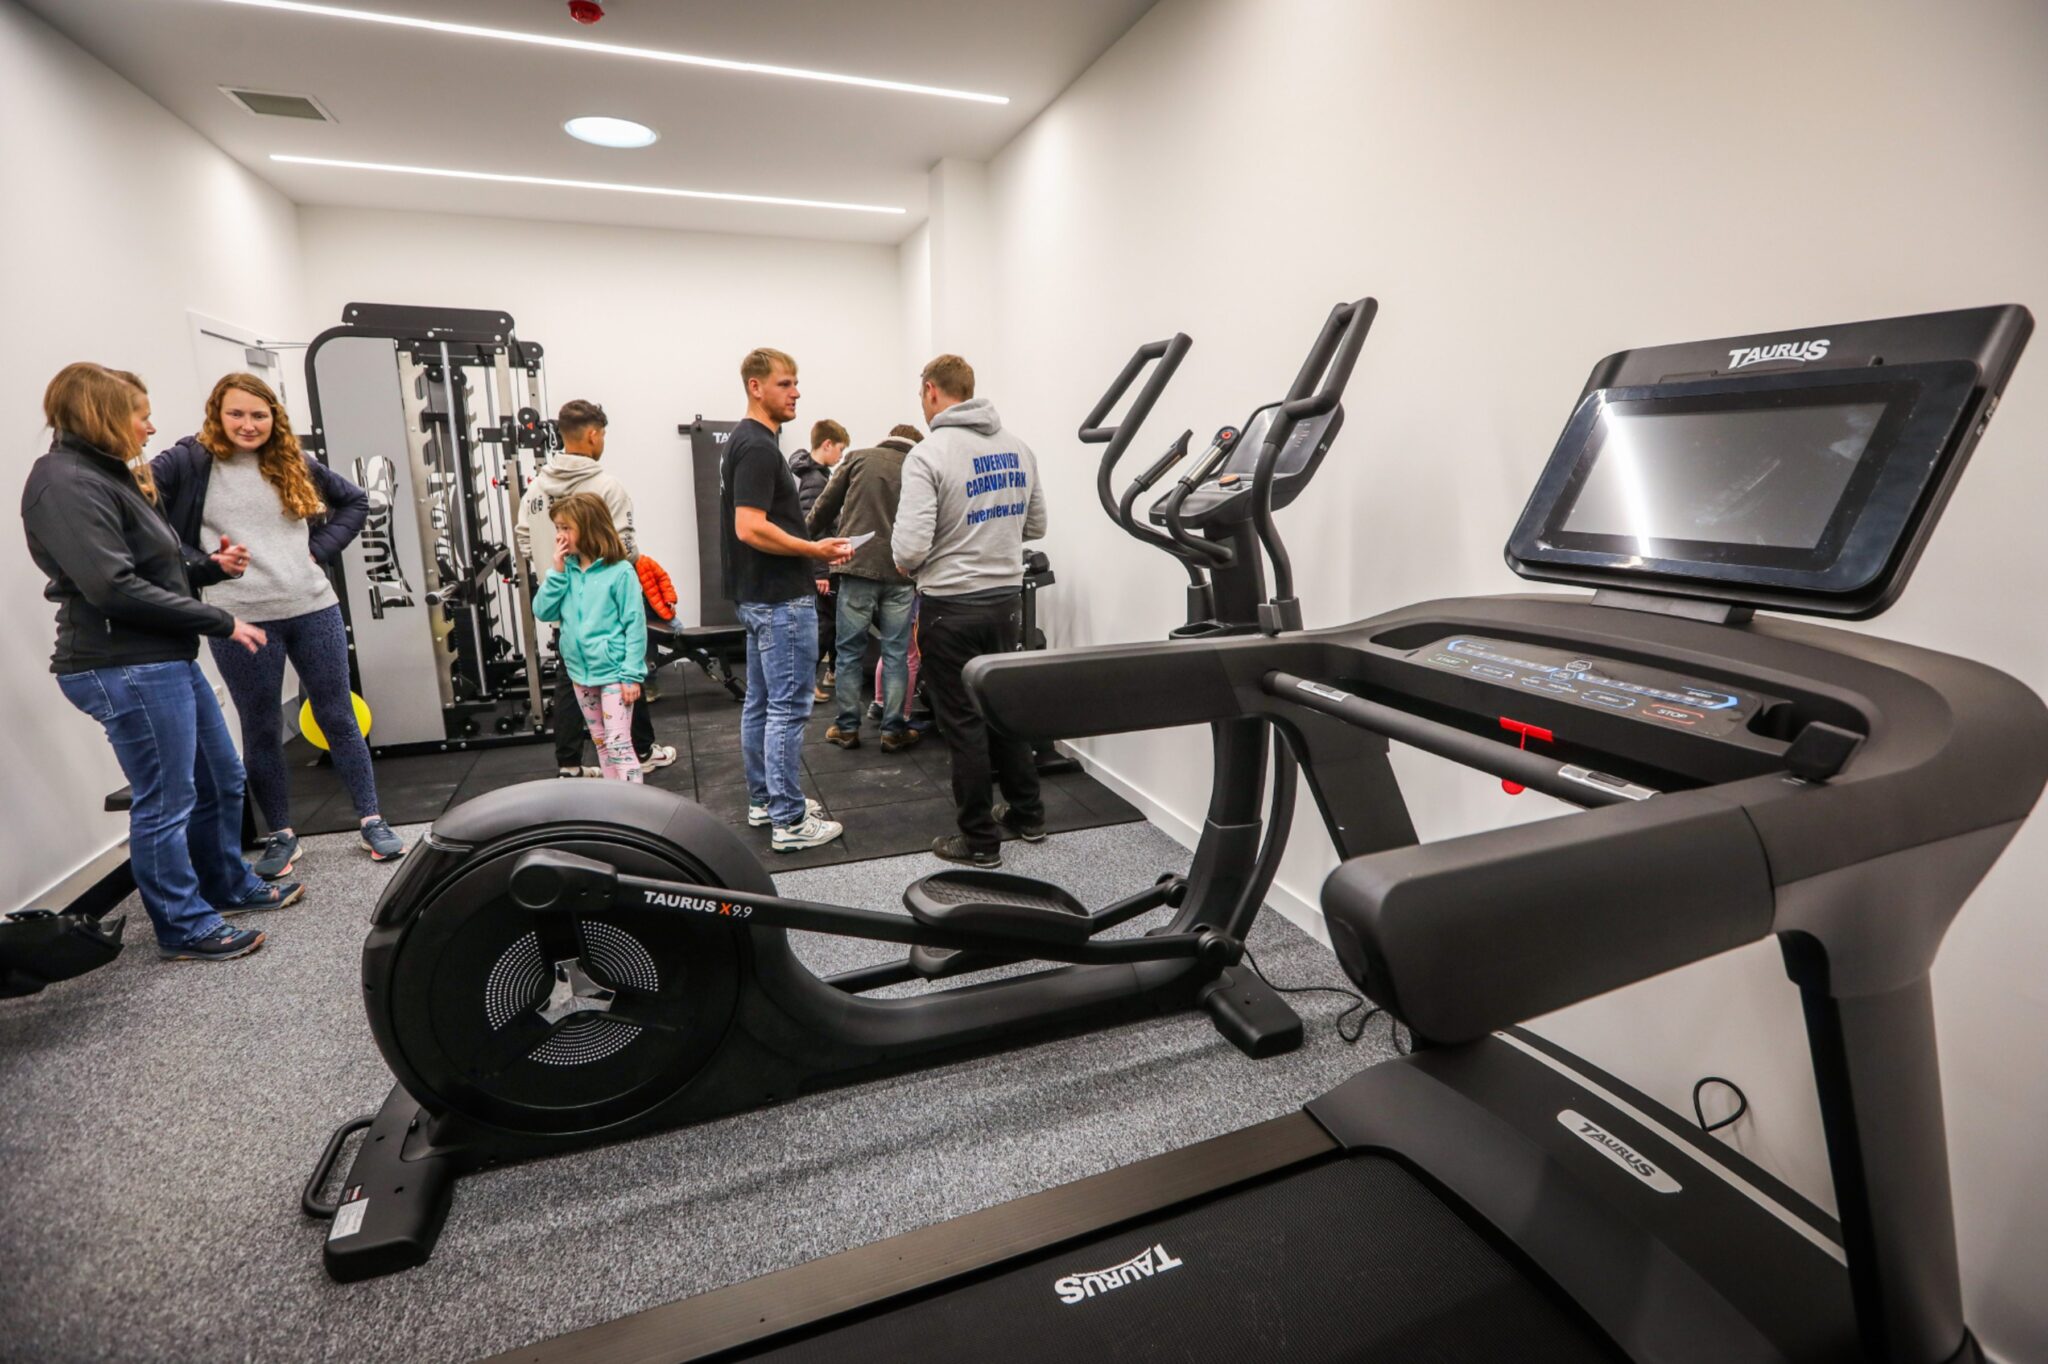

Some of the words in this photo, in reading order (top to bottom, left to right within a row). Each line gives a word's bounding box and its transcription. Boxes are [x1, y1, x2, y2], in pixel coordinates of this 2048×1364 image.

[1727, 339, 1831, 369] TAURUS
[973, 453, 1019, 474] RIVERVIEW
[966, 472, 1007, 498] CARAVAN
[1008, 471, 1026, 488] PRK
[1657, 708, 1688, 719] STOP
[644, 891, 717, 913] TAURUS
[719, 902, 753, 918] X9.9
[1579, 1122, 1656, 1177] TAURUS
[1054, 1243, 1183, 1304] TAURUS
